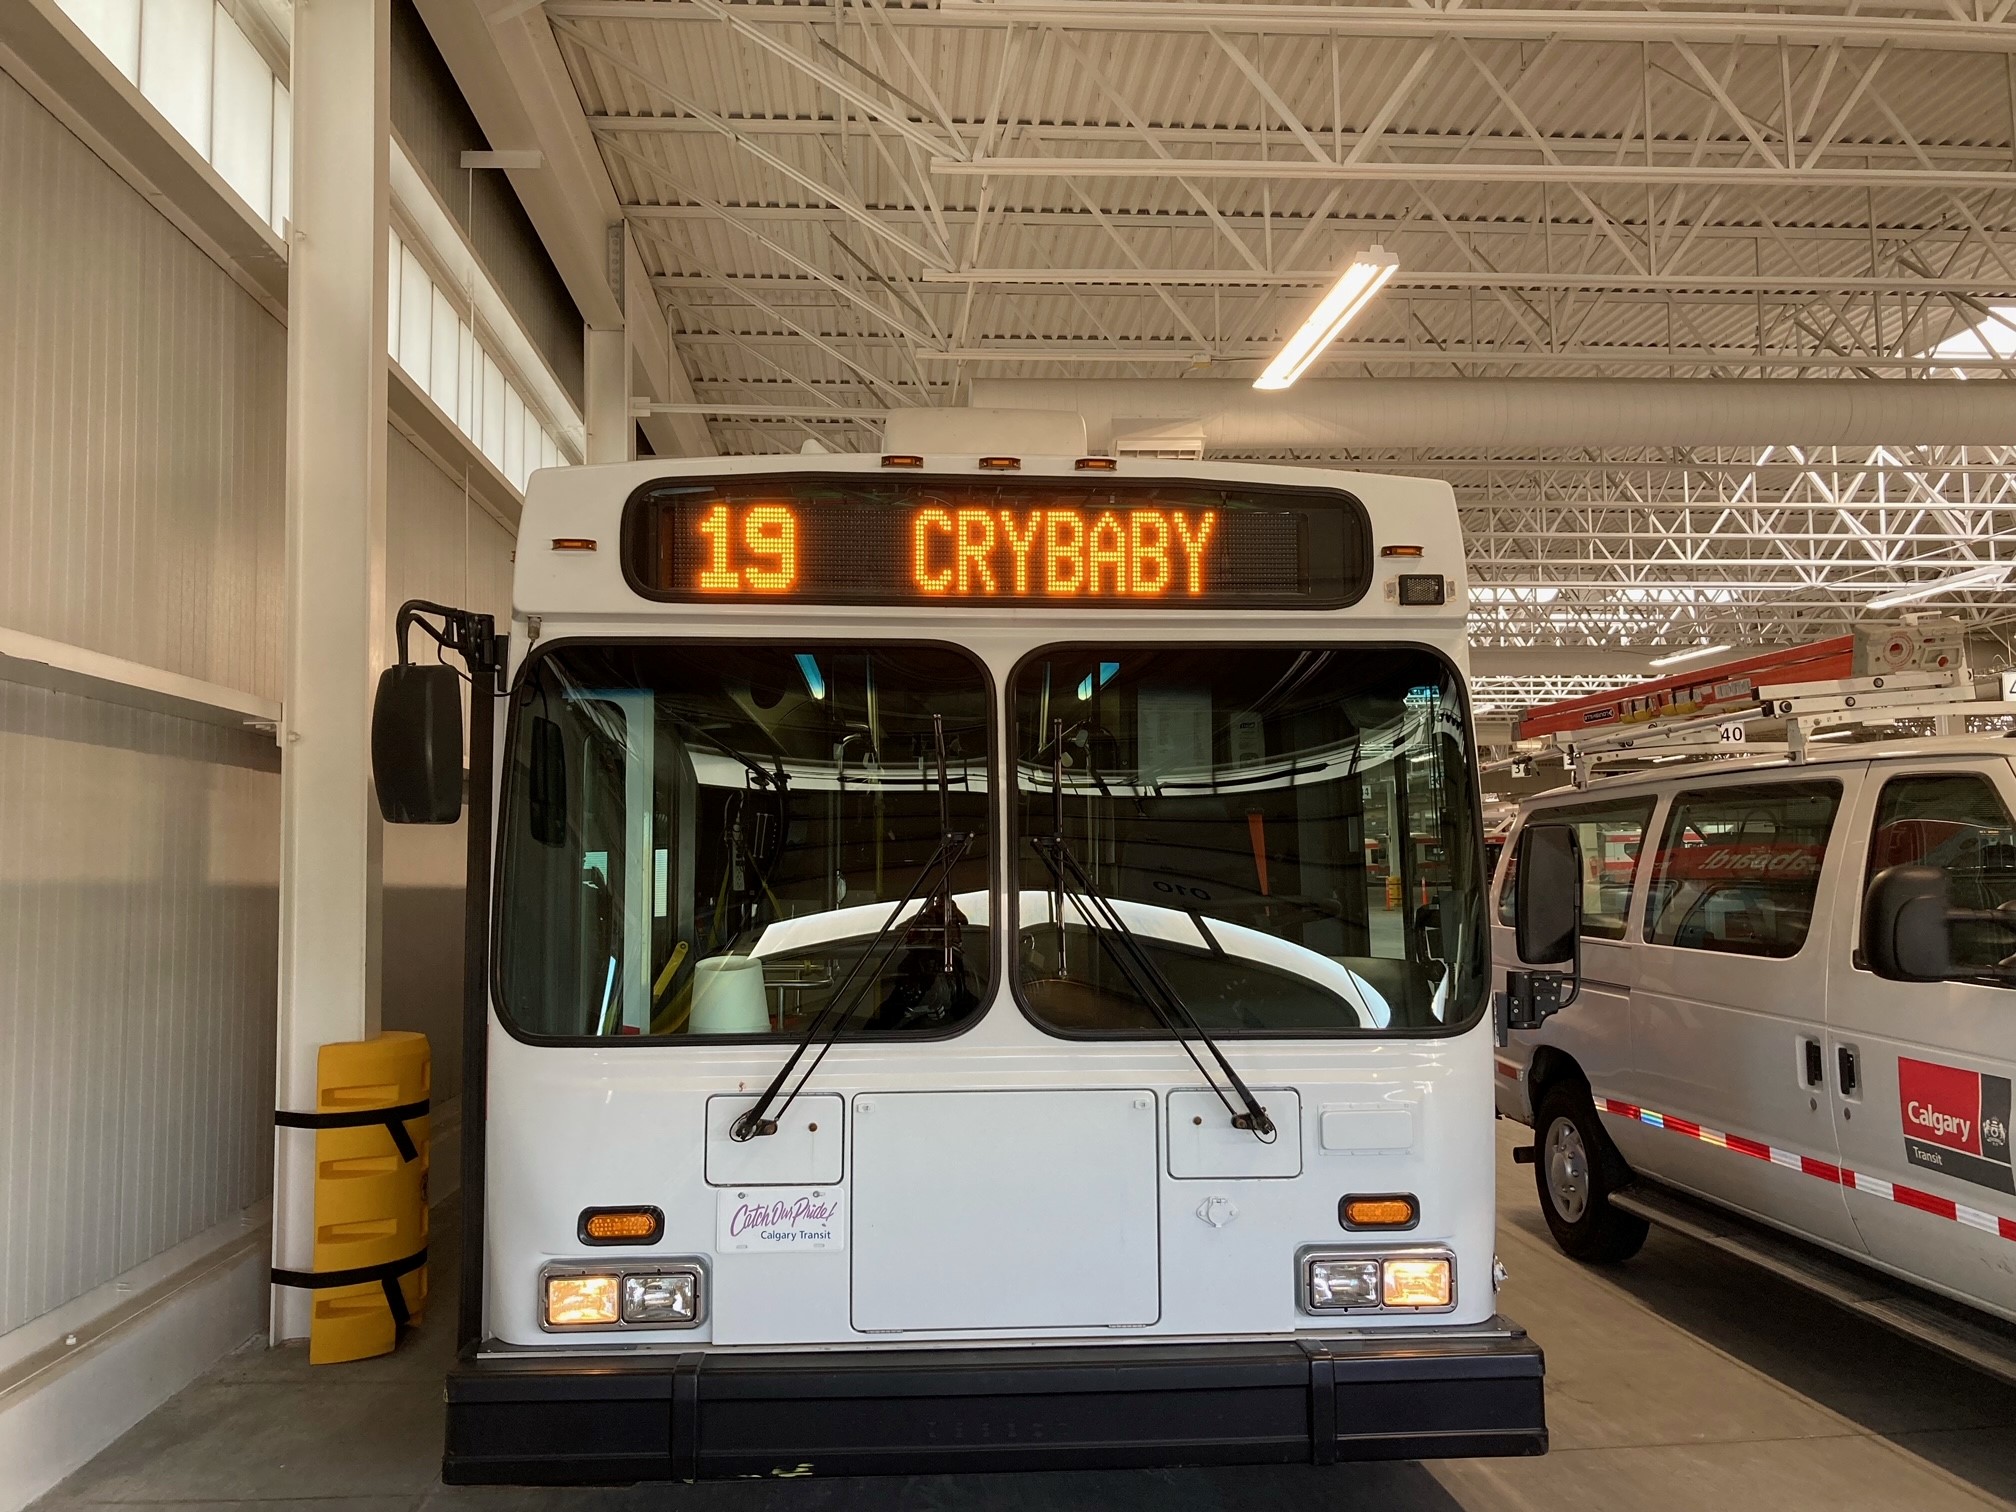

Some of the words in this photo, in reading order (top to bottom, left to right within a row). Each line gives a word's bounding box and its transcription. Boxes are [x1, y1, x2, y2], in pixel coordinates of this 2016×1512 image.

[701, 506, 795, 589] 19
[915, 509, 1214, 592] CRYBABY
[1721, 726, 1743, 742] 40
[1907, 1101, 1971, 1142] Calgary
[1912, 1146, 1943, 1165] Transit
[730, 1203, 770, 1237] Catch
[771, 1200, 792, 1226] Our
[791, 1196, 838, 1228] Pride!
[760, 1230, 797, 1241] Calgary
[799, 1230, 831, 1240] Transit
